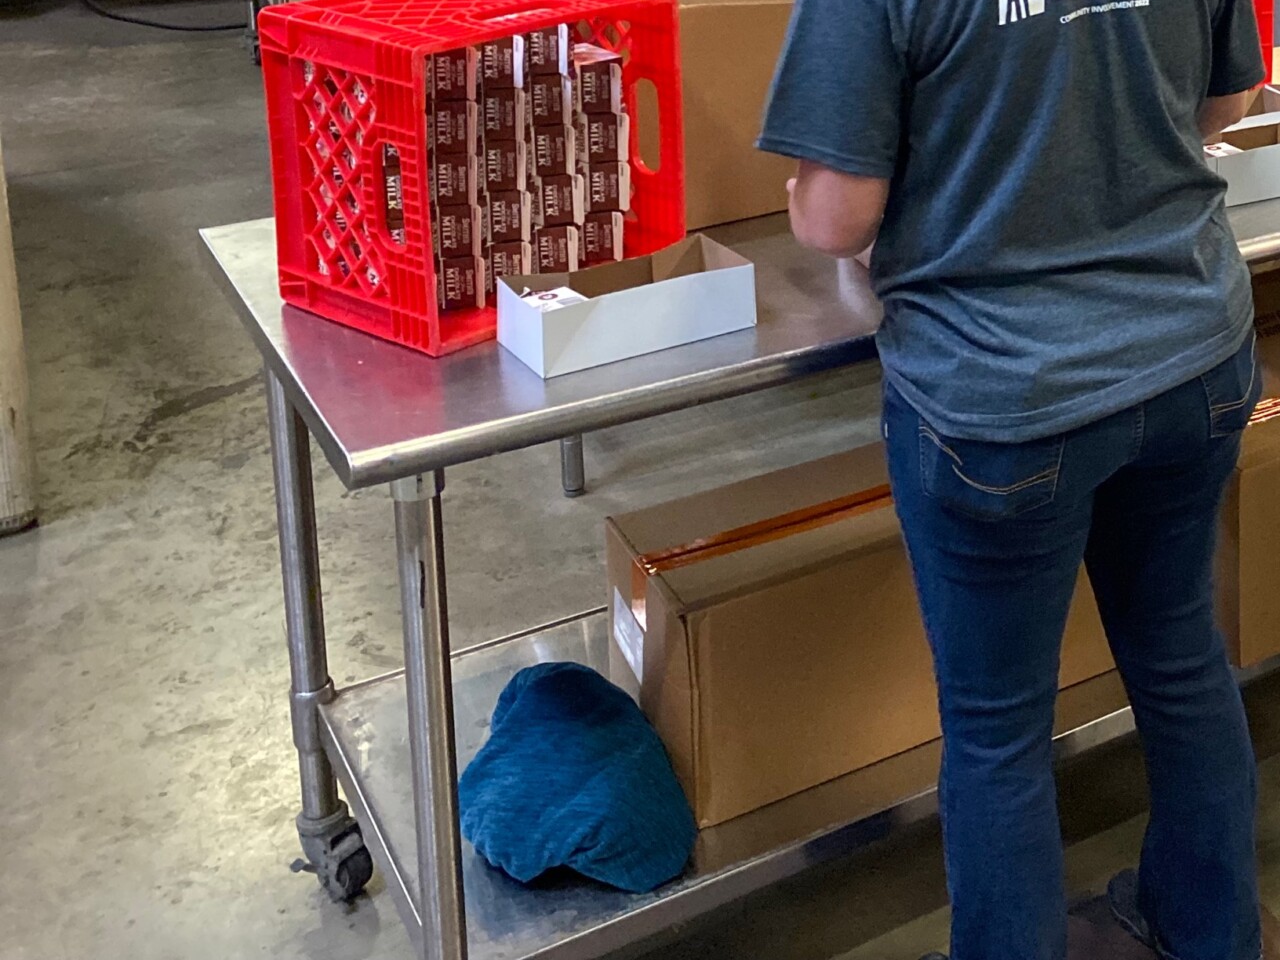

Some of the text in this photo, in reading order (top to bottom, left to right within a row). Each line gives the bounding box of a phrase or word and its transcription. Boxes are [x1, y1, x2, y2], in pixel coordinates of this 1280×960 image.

[484, 45, 493, 78] MILK
[530, 32, 539, 64] MILK
[436, 57, 447, 90] MILK
[582, 72, 592, 103] MILK
[486, 98, 496, 130] MILK
[534, 84, 543, 116] MILK
[437, 111, 447, 144] MILK
[590, 122, 599, 154] MILK
[488, 150, 496, 180] MILK
[537, 135, 546, 167] MILK
[386, 176, 397, 209] MILK
[438, 164, 448, 197] MILK
[592, 172, 600, 202] MILK
[492, 201, 502, 232] MILK
[544, 185, 554, 216] MILK
[442, 216, 452, 248] MILK
[586, 222, 596, 252] MILK
[494, 252, 502, 278] MIL
[540, 236, 550, 268] MILK
[446, 268, 456, 300] MILK
